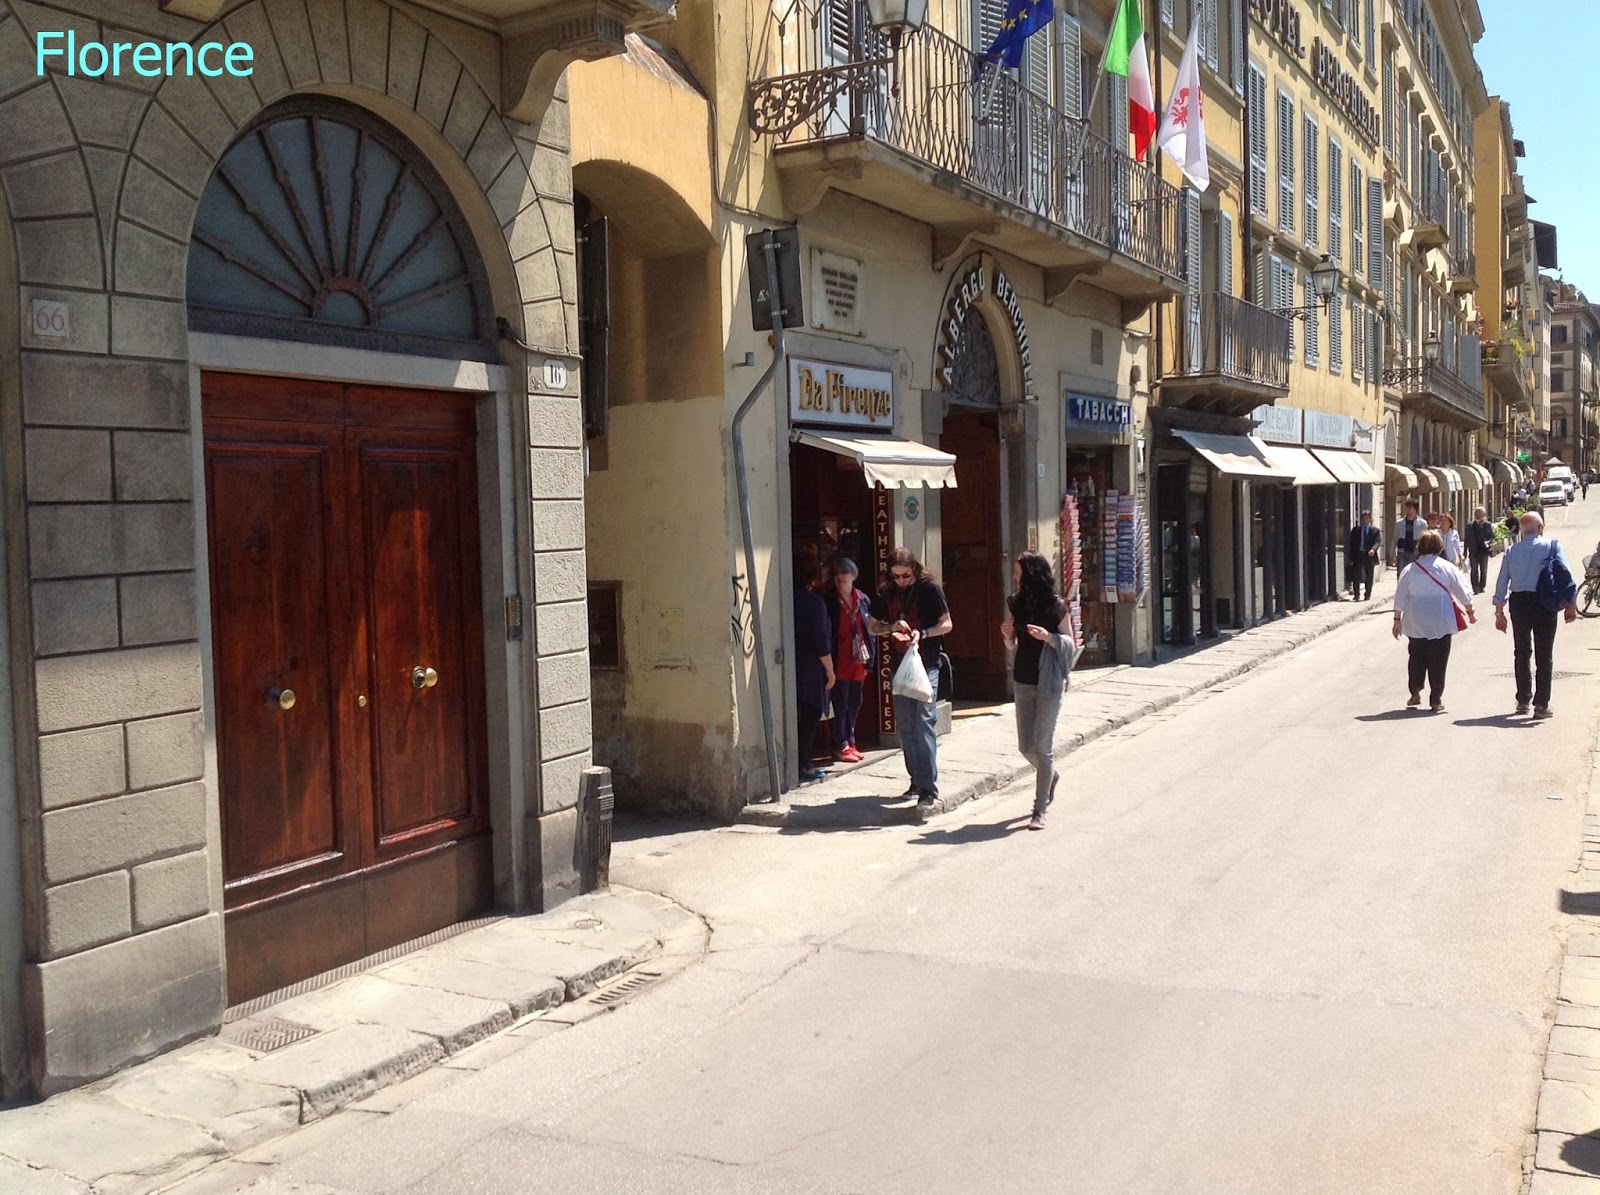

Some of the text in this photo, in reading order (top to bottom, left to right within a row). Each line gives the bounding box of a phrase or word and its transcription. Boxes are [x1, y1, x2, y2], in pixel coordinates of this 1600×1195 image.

[36, 305, 64, 331] 66
[943, 267, 1034, 401] ALBERGO BERCHIELLI
[550, 364, 562, 384] 16
[798, 364, 891, 422] Da Firenze
[1076, 398, 1134, 424] TABACCHI
[876, 481, 893, 731] LEATHER SSORIES
